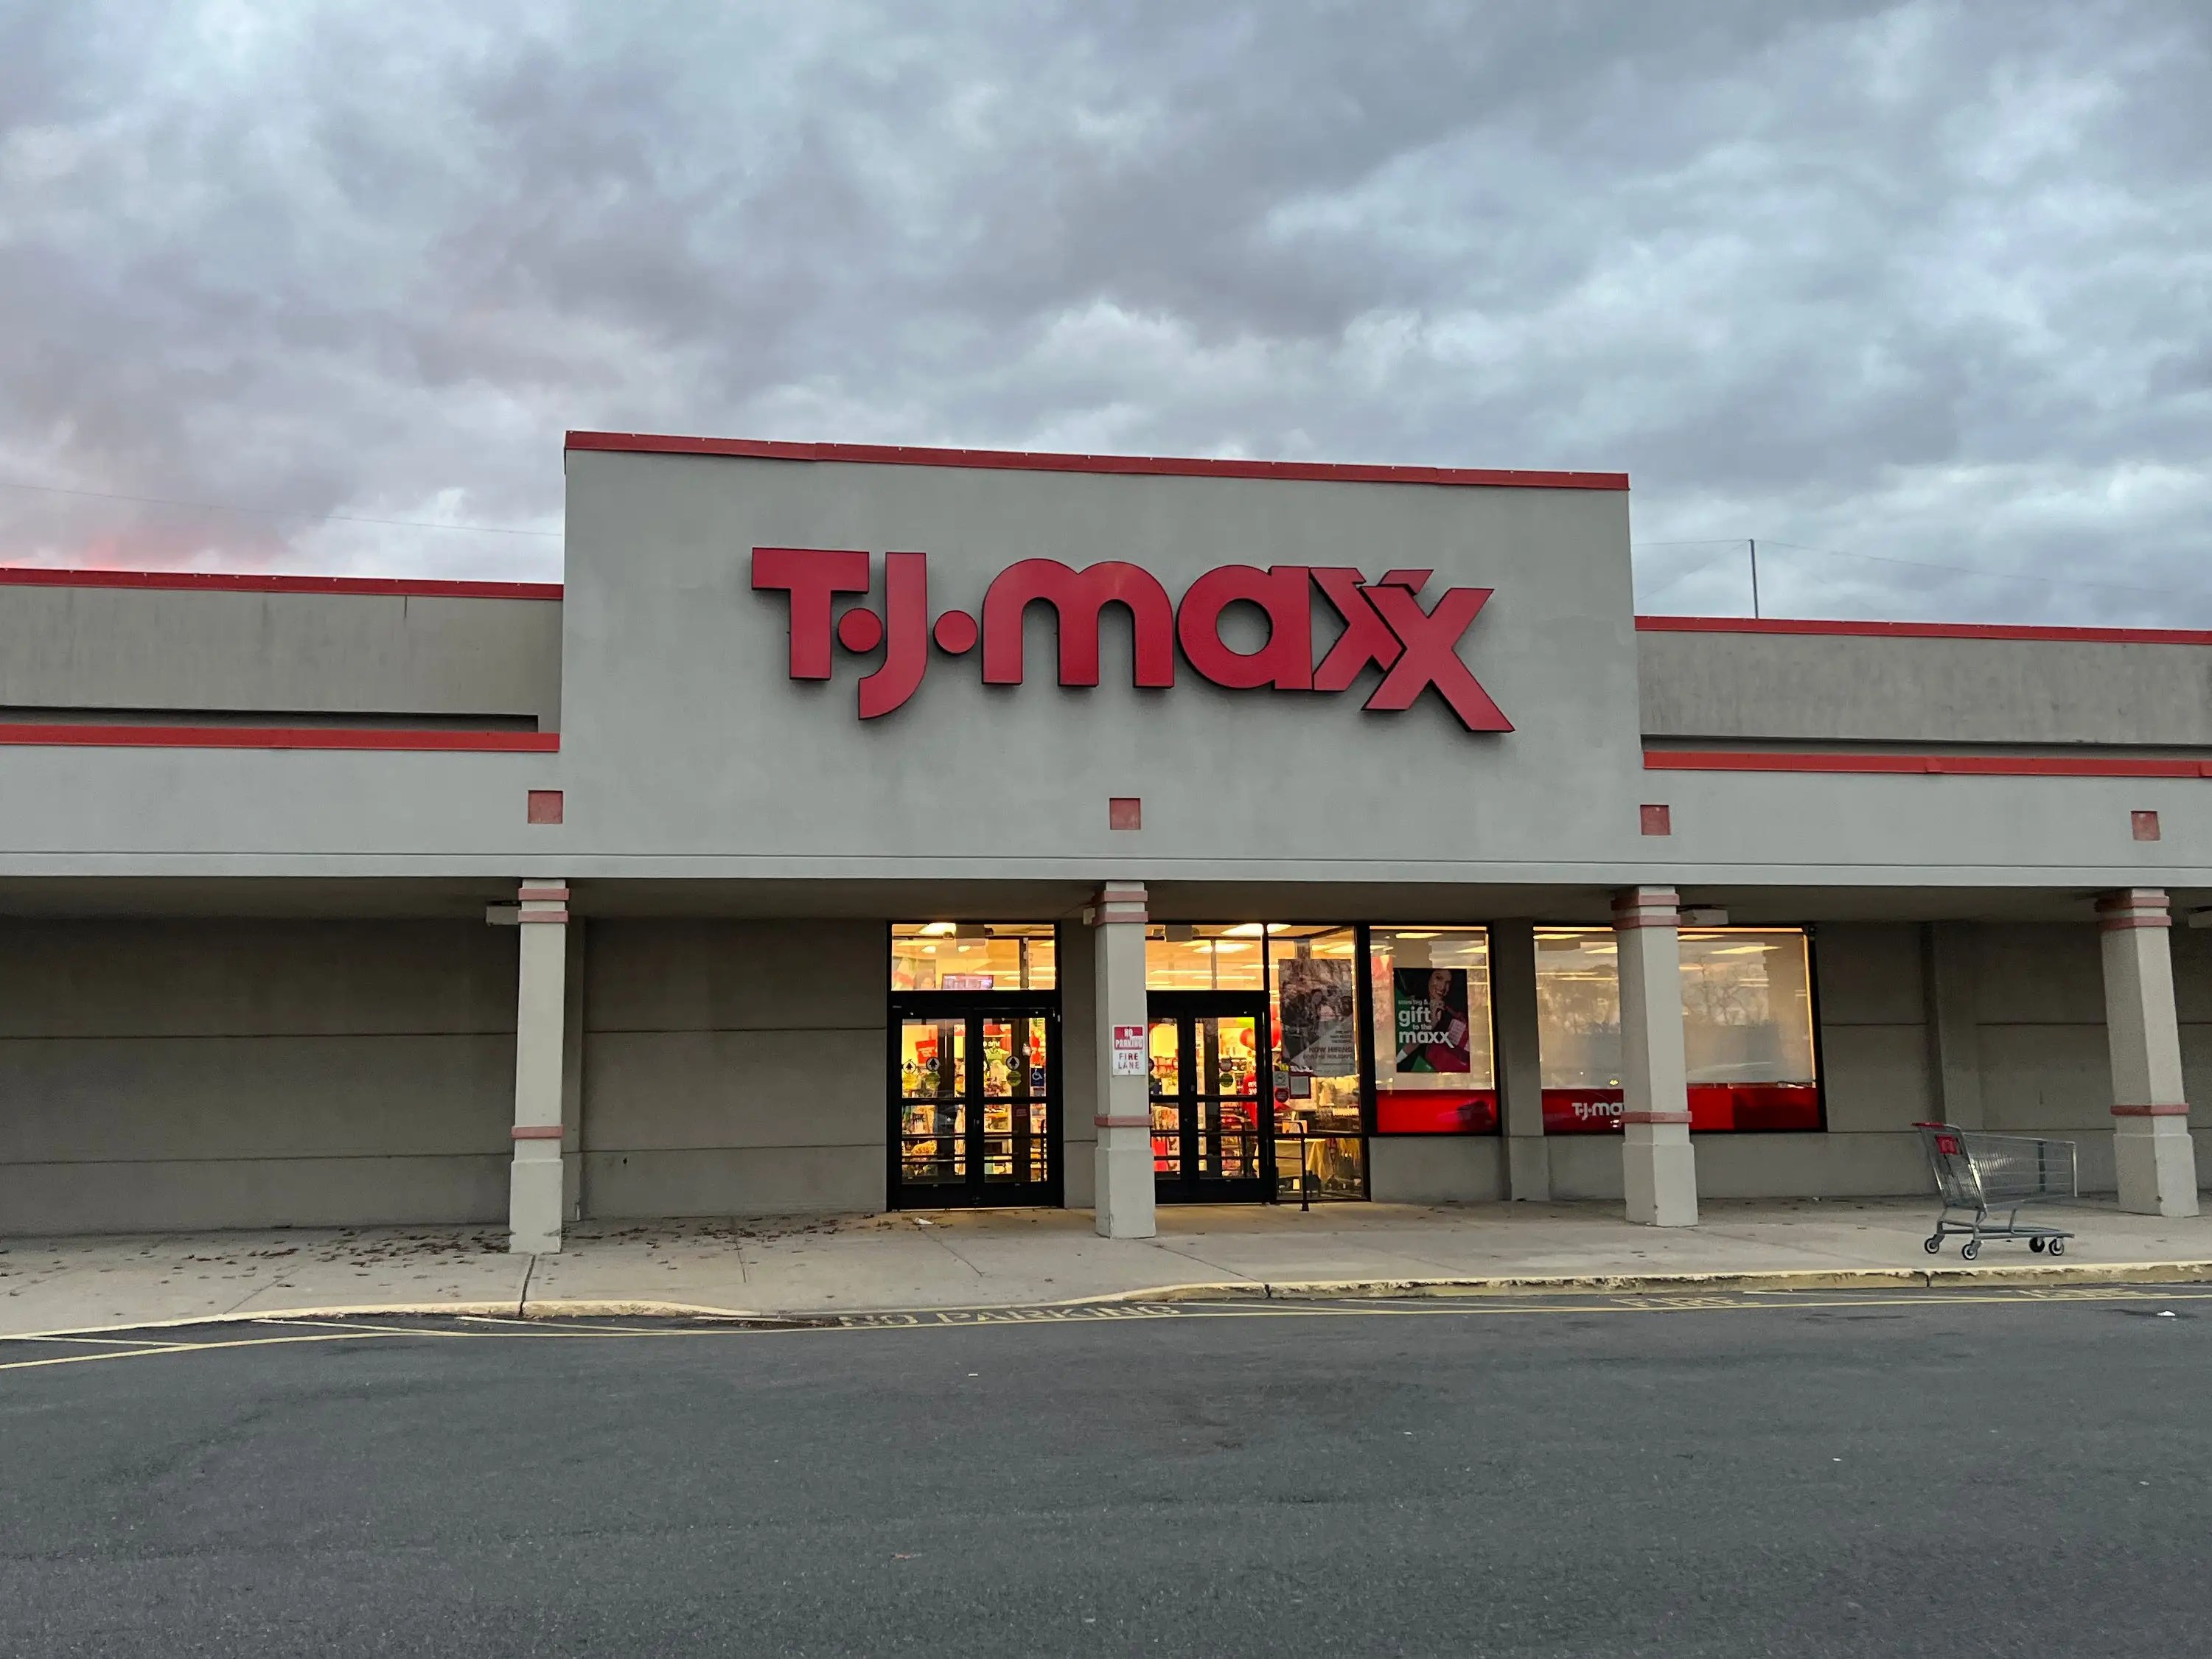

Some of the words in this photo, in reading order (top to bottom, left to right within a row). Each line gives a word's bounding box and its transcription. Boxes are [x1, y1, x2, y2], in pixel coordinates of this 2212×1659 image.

[1398, 1006, 1431, 1027] gift
[1124, 1028, 1133, 1037] NO
[1115, 1038, 1143, 1048] PARKING
[1399, 1031, 1455, 1049] maxx
[1119, 1052, 1139, 1061] FIRE
[1117, 1061, 1140, 1069] LANE
[1571, 1102, 1624, 1121] T·J·ma
[837, 1313, 918, 1327] NO
[935, 1304, 1180, 1324] PARKING
